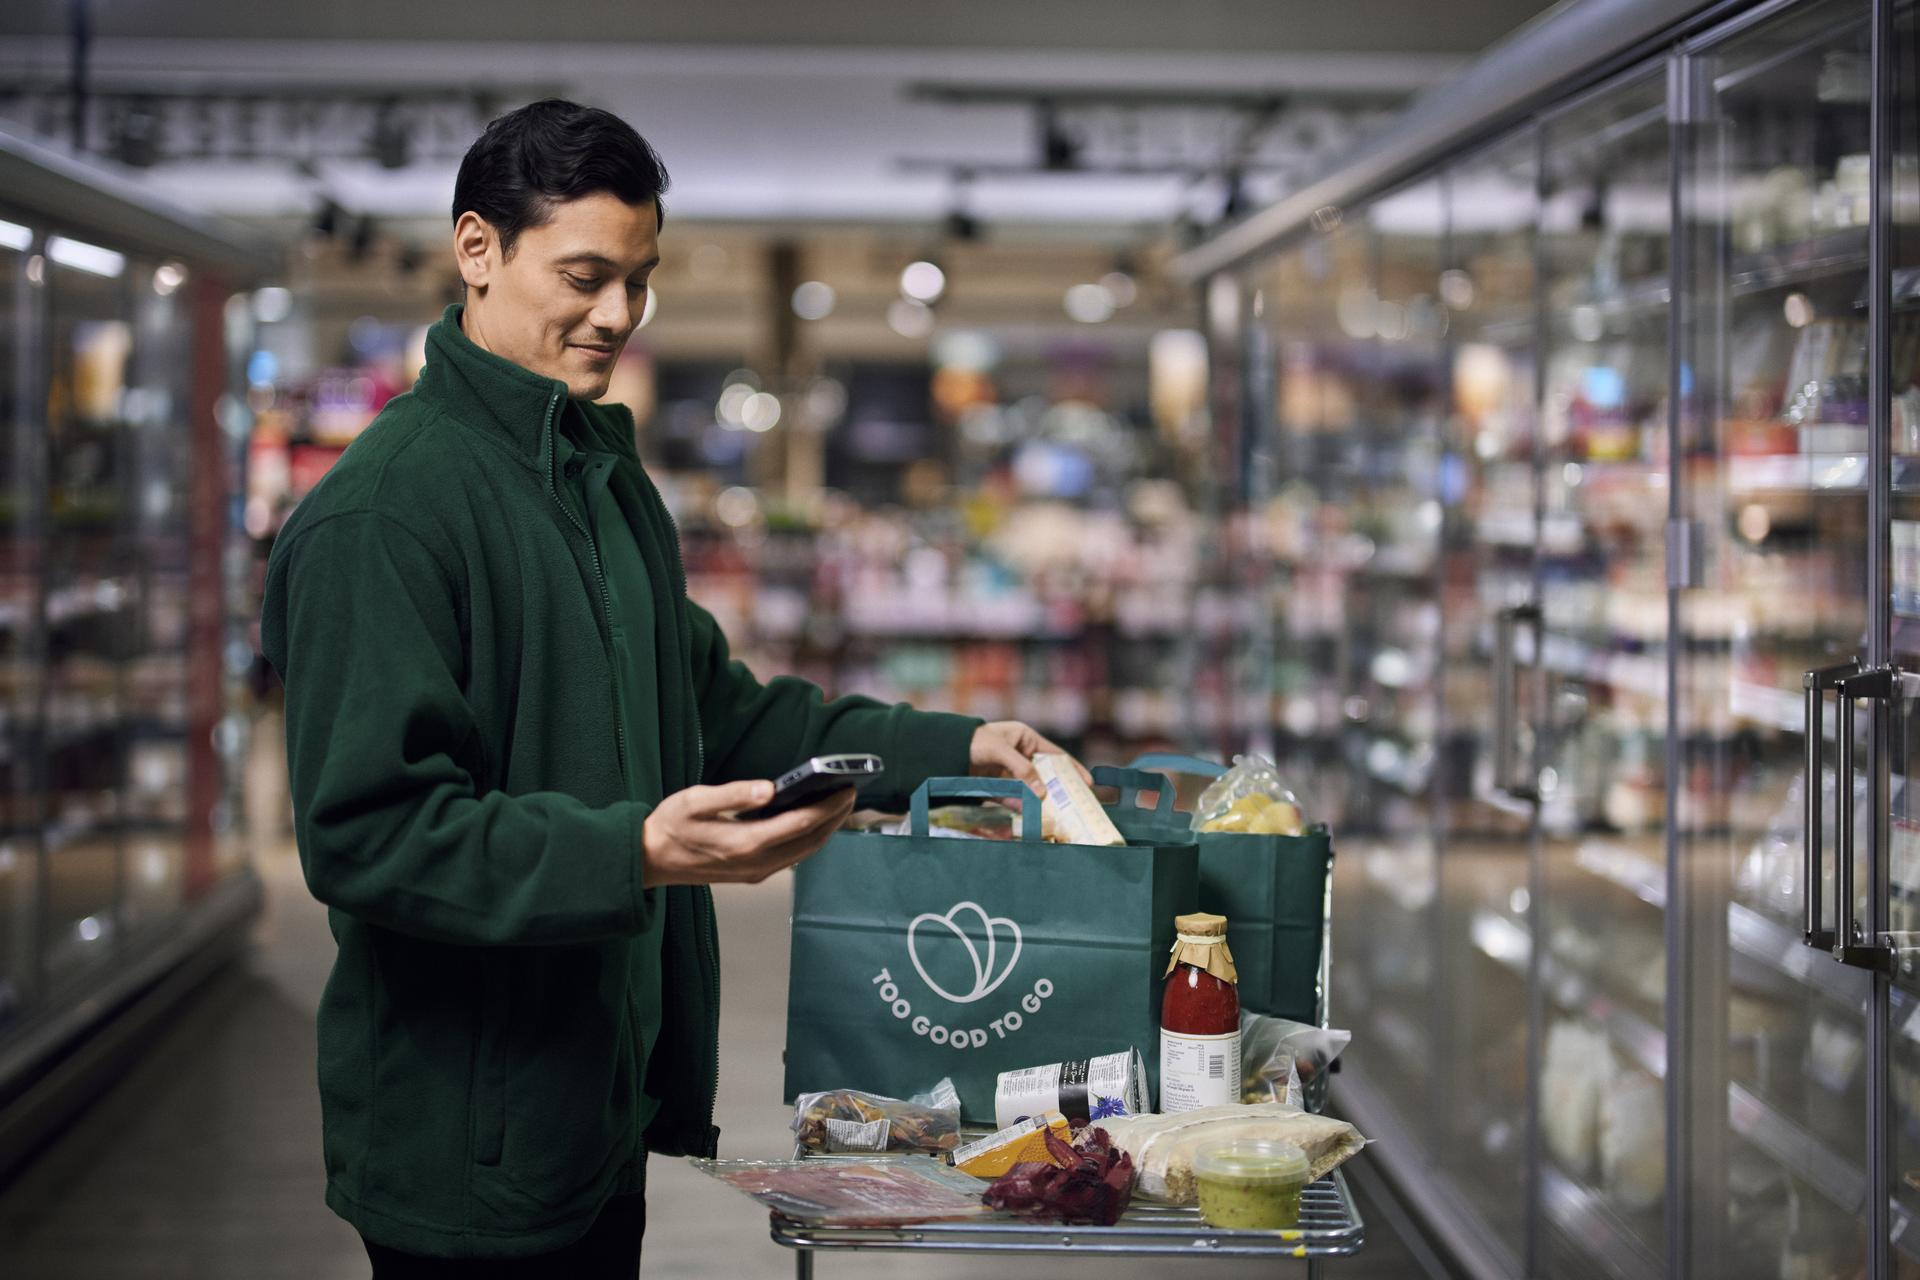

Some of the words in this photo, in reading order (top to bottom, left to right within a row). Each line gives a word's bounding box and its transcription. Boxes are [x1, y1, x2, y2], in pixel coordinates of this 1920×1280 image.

[872, 967, 911, 1019] TOO
[912, 1015, 988, 1049] GOOD
[989, 1011, 1023, 1039] TO
[1021, 978, 1054, 1013] GO
